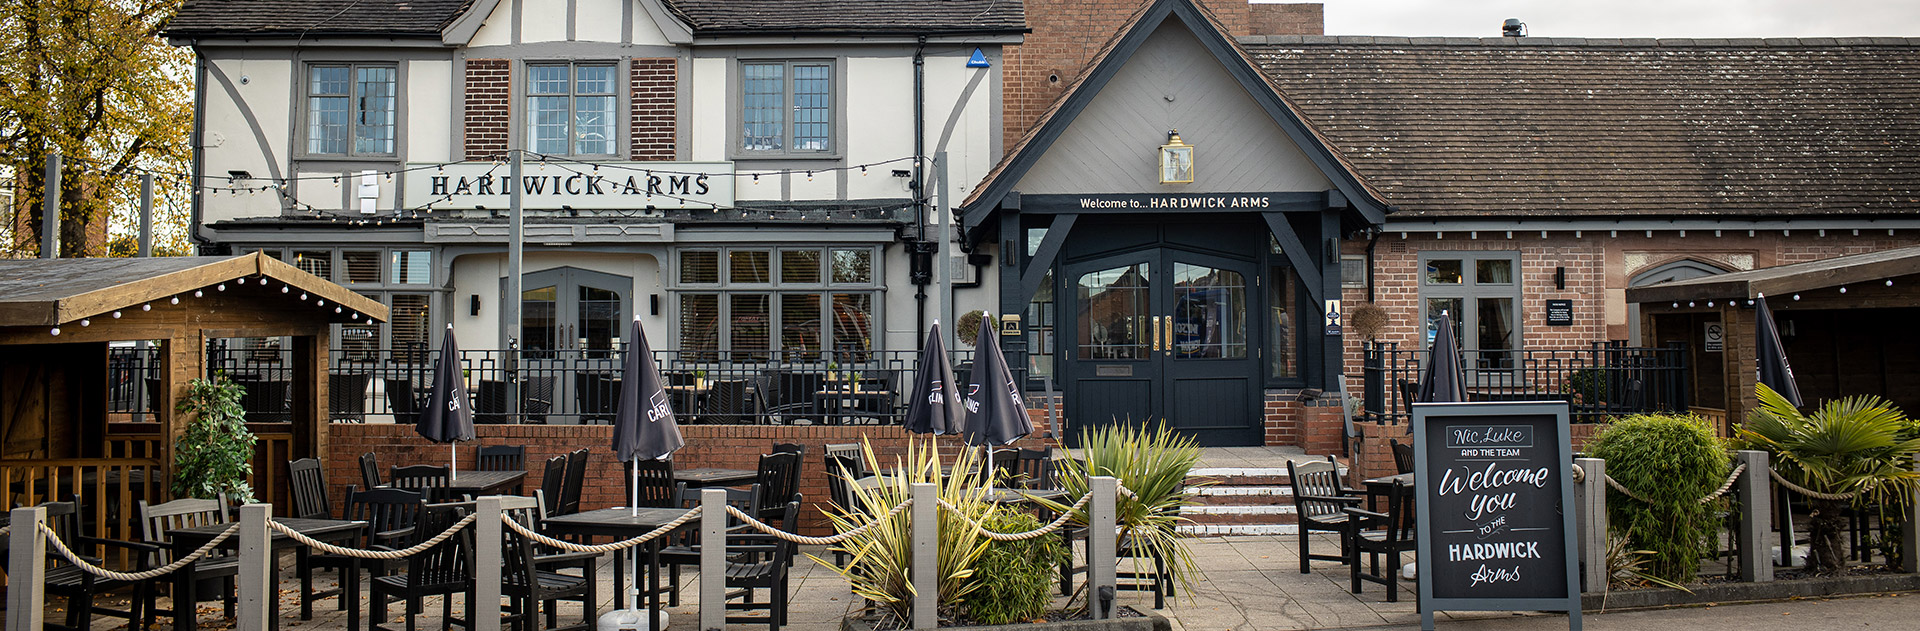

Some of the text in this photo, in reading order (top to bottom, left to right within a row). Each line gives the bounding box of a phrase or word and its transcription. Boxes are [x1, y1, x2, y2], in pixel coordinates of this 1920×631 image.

[431, 175, 709, 195] HARDWICK ARMS
[1080, 197, 1270, 208] Welcome to... HARDWICK ARMS
[1483, 426, 1526, 443] Luke
[1461, 448, 1521, 457] AND THE TEAM
[1438, 462, 1549, 496] Welcome
[1464, 492, 1517, 521] you
[1479, 516, 1506, 536] TO THE
[1448, 541, 1542, 562] HARDWICK
[1470, 563, 1521, 588] Arms
